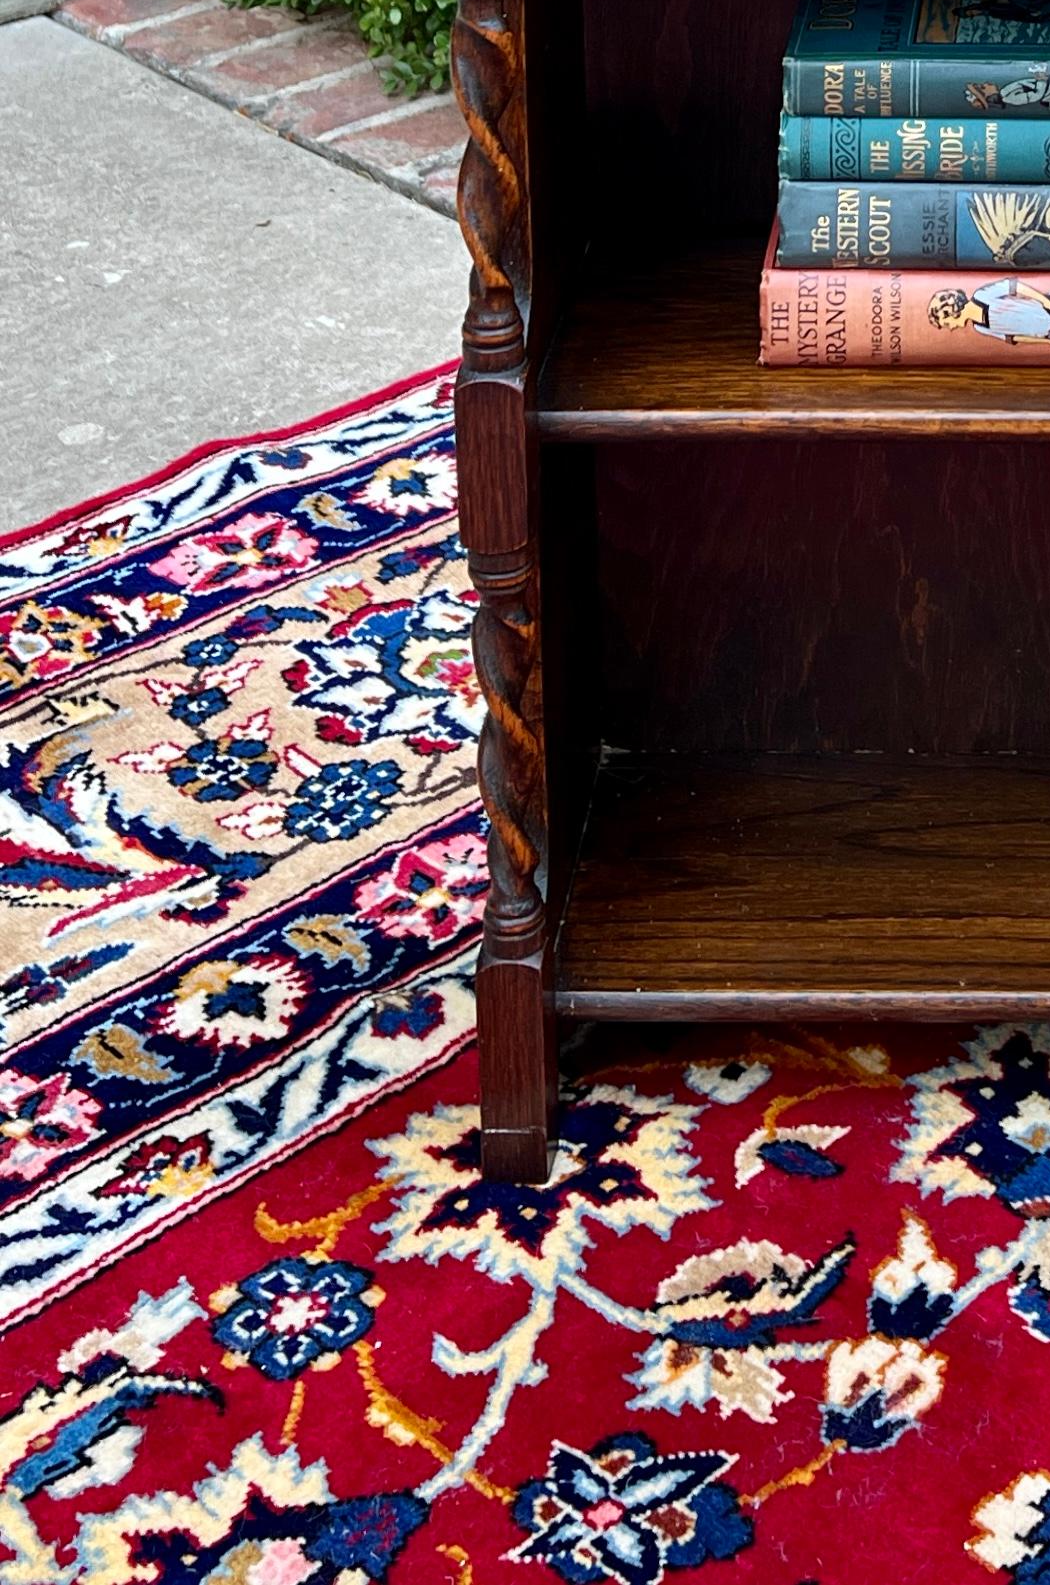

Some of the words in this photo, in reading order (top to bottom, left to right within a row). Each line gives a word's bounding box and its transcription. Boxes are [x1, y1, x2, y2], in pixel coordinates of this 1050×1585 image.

[824, 63, 845, 115] DORA
[854, 68, 866, 102] TALE
[854, 104, 866, 114] A
[866, 83, 878, 100] OF
[870, 140, 890, 174] THE
[811, 216, 830, 253] The
[864, 195, 892, 265] SCOUT
[922, 200, 936, 256] ESSIE
[797, 271, 819, 365] MYSTERY
[826, 275, 847, 365] GRANGE
[872, 286, 883, 356] THEODORA
[890, 272, 901, 322] WILSON
[771, 301, 789, 346] THE
